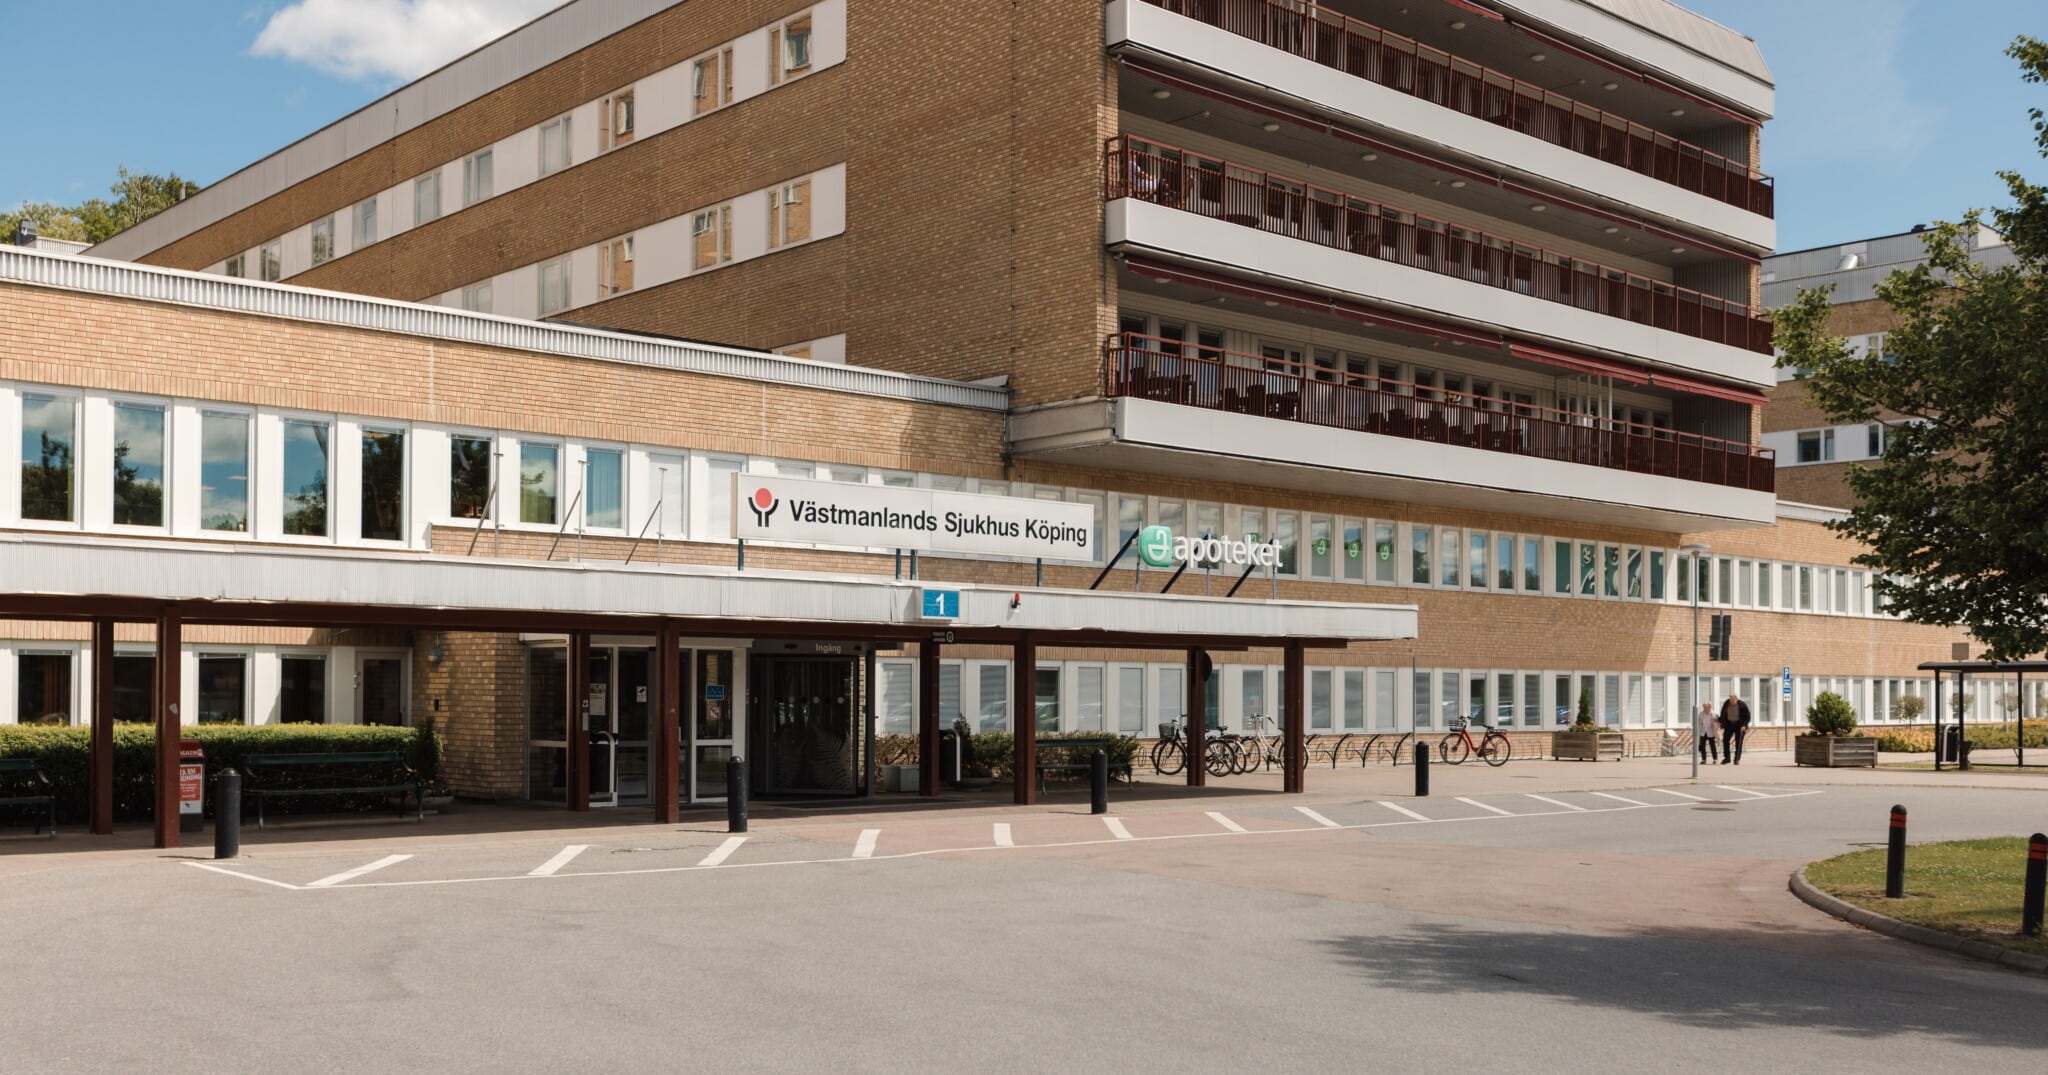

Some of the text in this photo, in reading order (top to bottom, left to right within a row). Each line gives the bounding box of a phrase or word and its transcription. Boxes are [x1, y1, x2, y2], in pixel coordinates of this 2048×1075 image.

[790, 499, 1087, 547] Västmanlands Sjukhus Köping
[1174, 534, 1284, 568] apoteket
[936, 593, 945, 615] 1
[815, 643, 842, 654] Ingång
